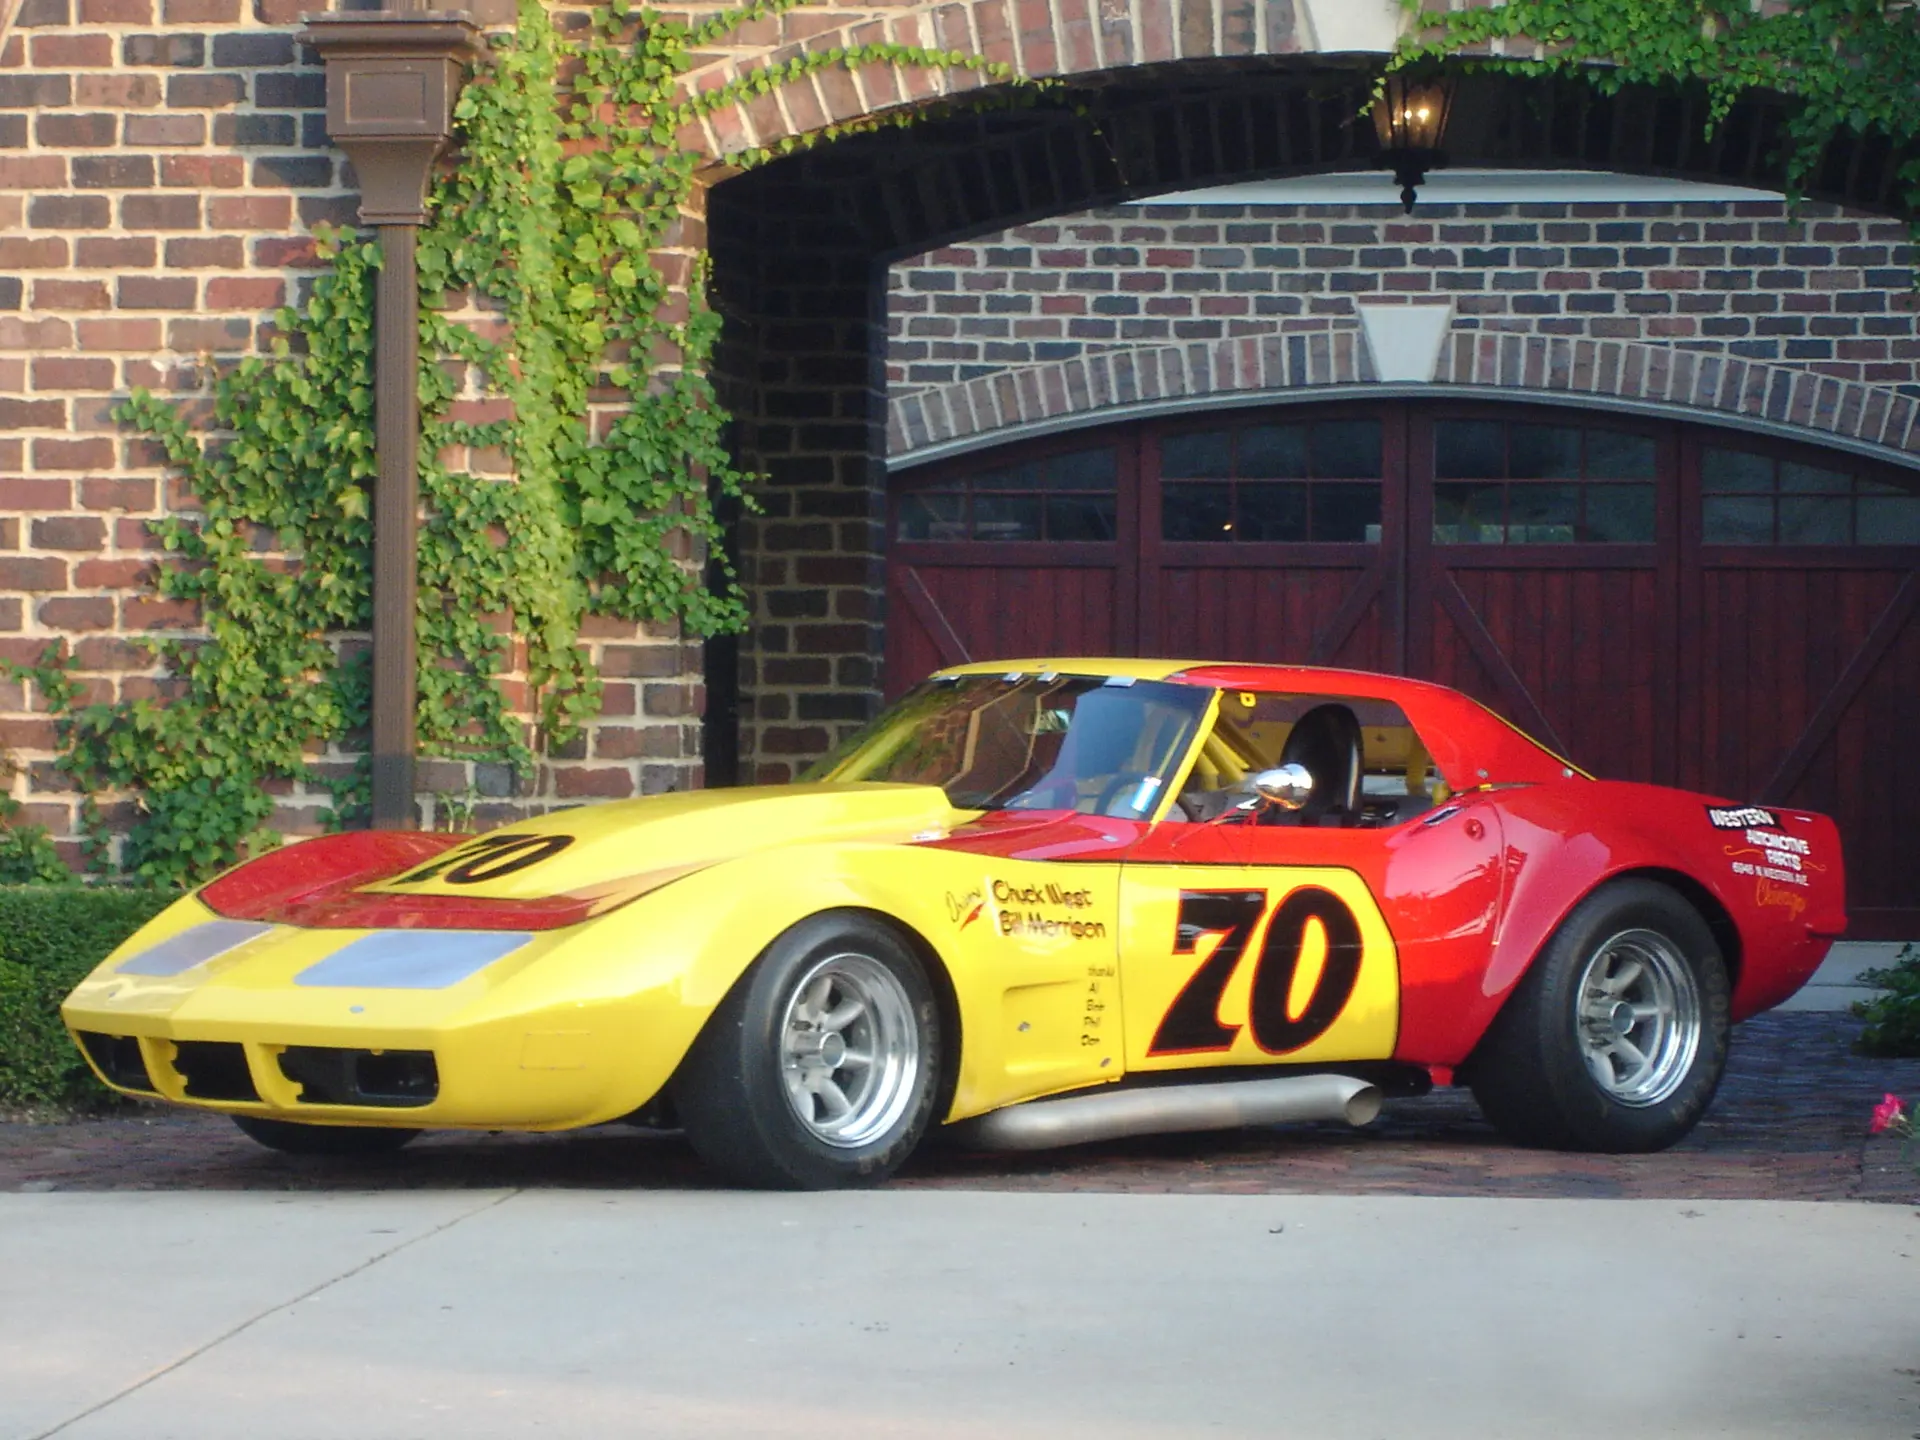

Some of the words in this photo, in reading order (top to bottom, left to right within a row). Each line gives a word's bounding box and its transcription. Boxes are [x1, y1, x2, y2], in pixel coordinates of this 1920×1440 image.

[1709, 808, 1774, 827] WESTERN
[388, 834, 576, 884] 70
[1765, 849, 1802, 871] PARTS
[993, 879, 1044, 904] Chuck
[1045, 883, 1092, 908] West
[1027, 912, 1106, 940] Morrison
[1145, 884, 1365, 1058] 70
